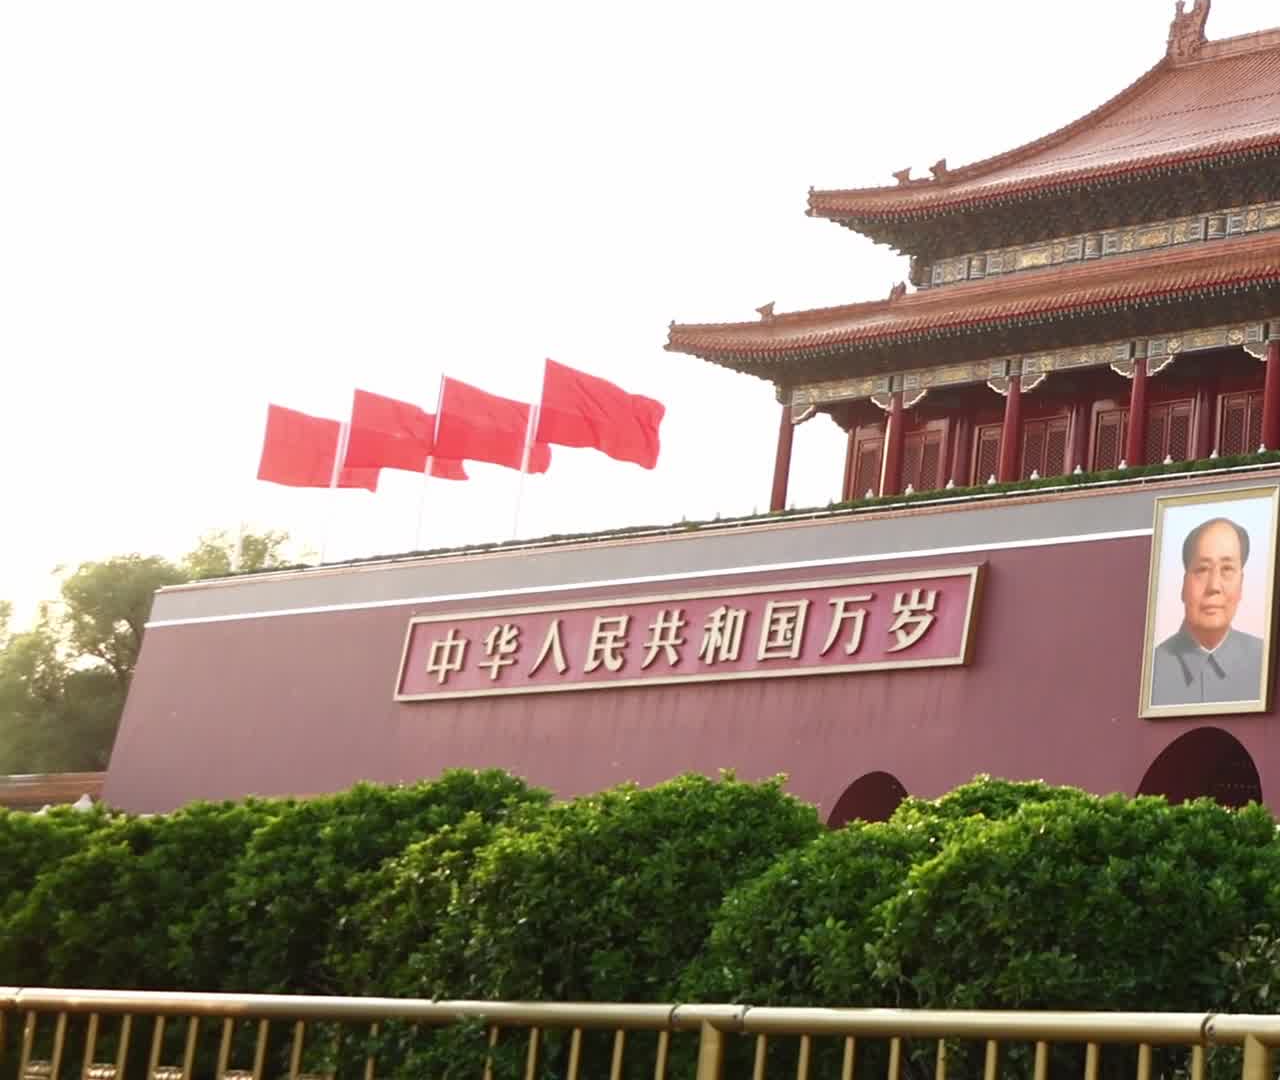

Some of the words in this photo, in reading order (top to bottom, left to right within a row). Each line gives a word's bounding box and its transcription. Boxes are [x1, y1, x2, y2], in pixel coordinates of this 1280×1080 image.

[424, 588, 940, 685] 中华人民共和国万岁
